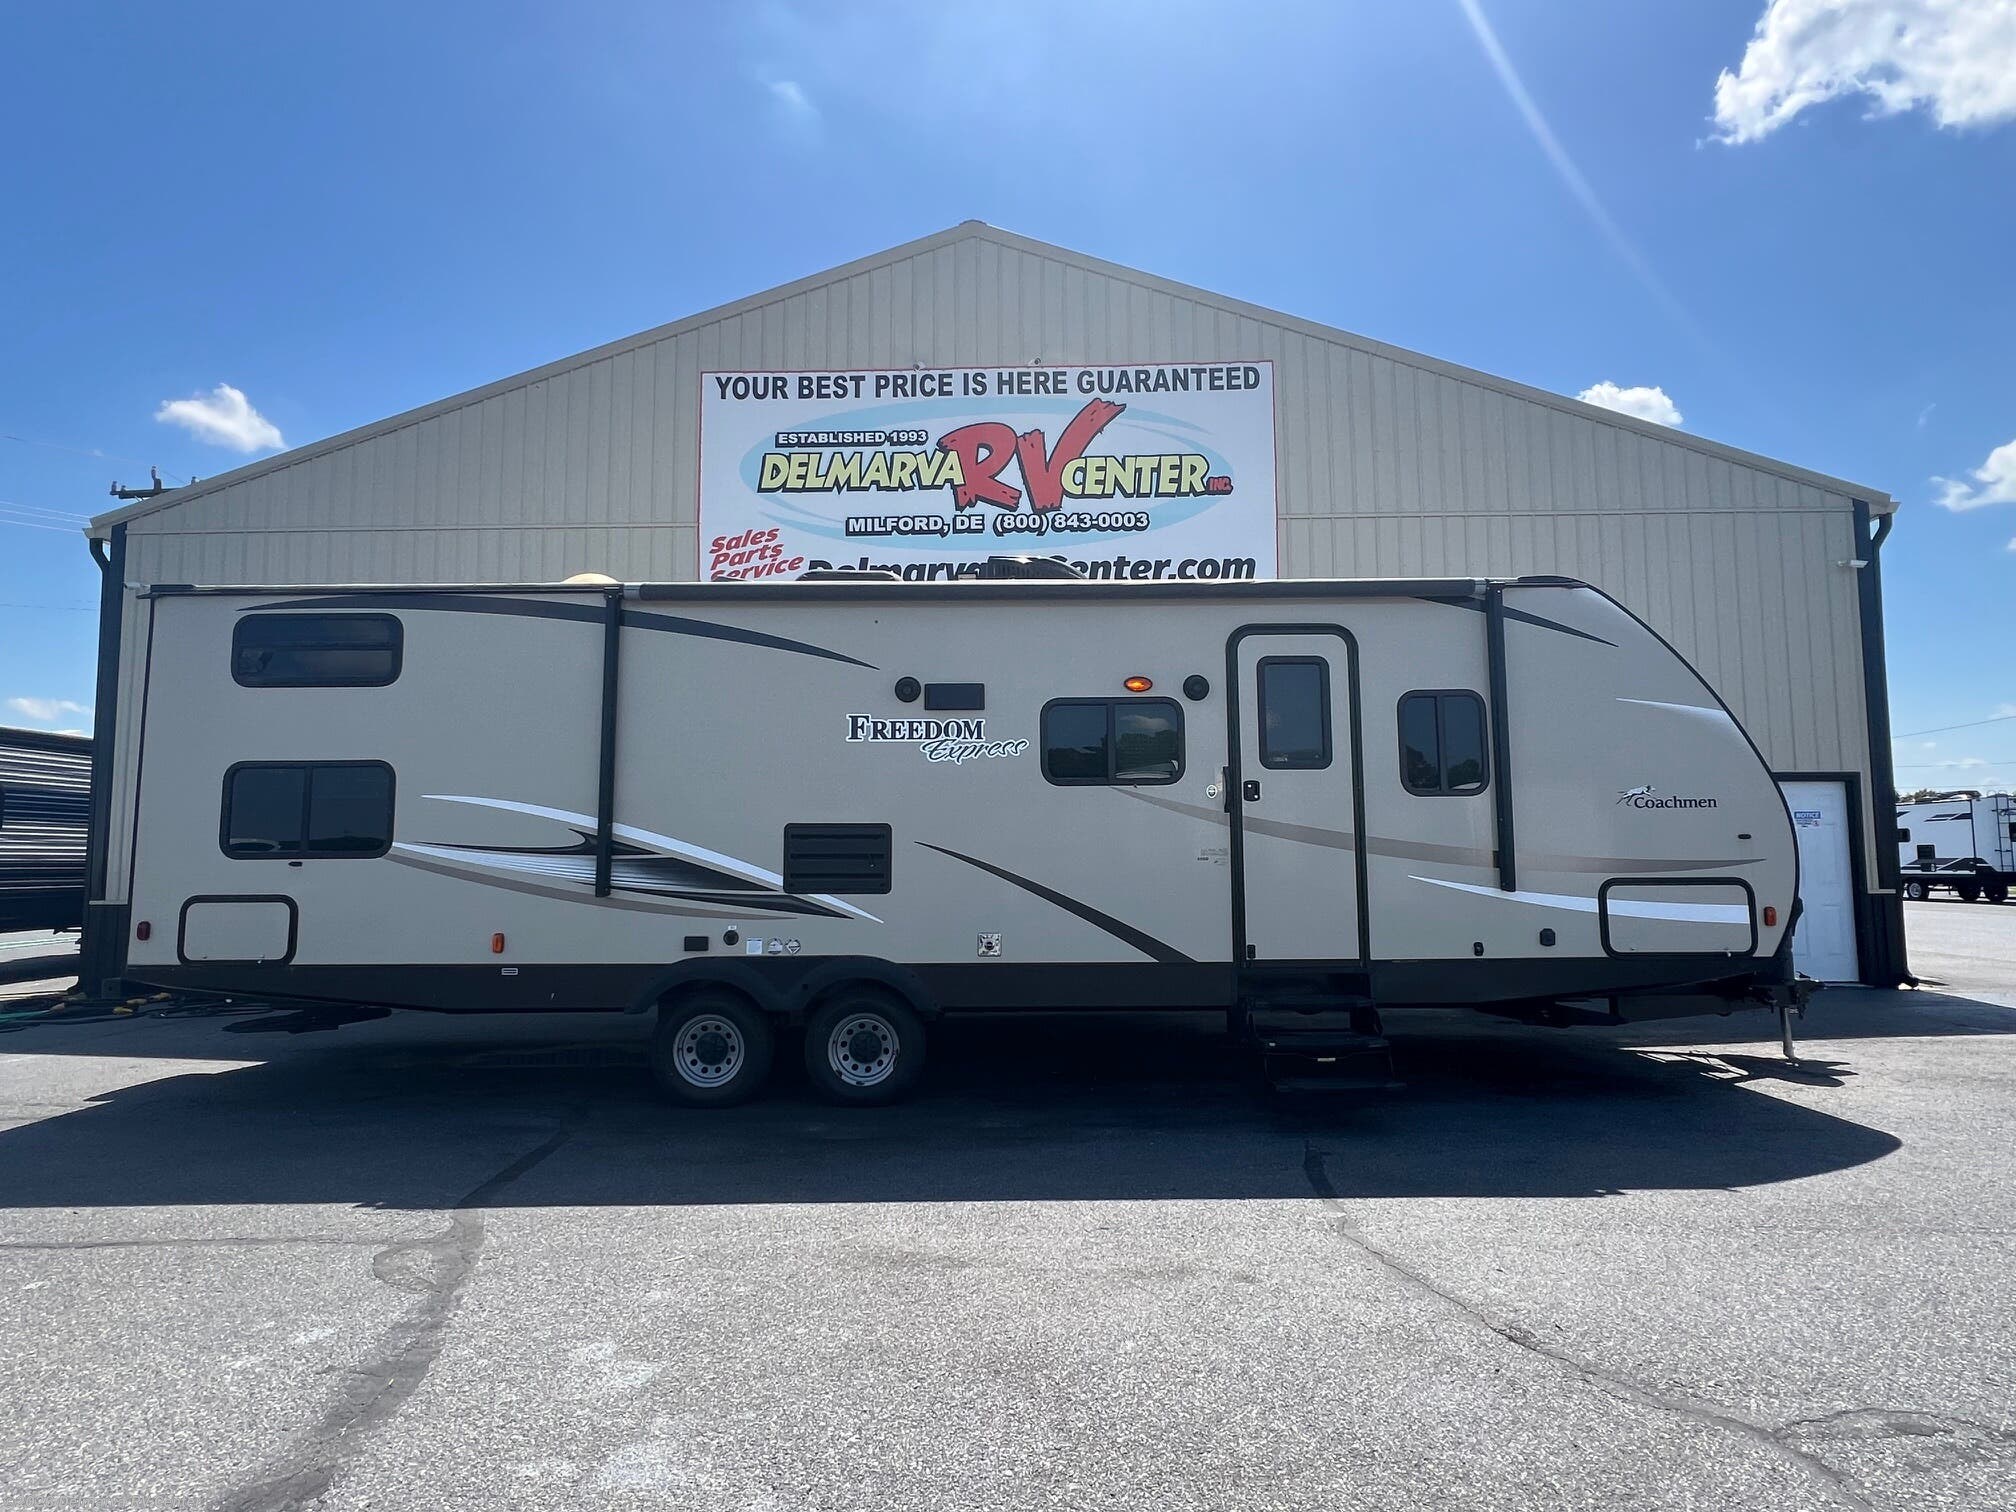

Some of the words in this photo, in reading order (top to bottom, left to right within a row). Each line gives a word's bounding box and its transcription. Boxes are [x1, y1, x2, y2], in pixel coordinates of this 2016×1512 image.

[715, 376, 789, 400] YOUR
[798, 375, 866, 399] BEST
[875, 373, 953, 398] PRICE
[963, 372, 988, 396] IS
[997, 371, 1068, 395] HERE
[1077, 366, 1261, 394] GUARANTEED
[777, 431, 886, 446] ESTABLISHED
[890, 430, 928, 443] 1993
[758, 450, 966, 493] DELMARVA
[937, 397, 1127, 513] RV
[1060, 454, 1210, 499] CENTER
[846, 516, 951, 538] MILFORD,
[954, 514, 985, 533] DE
[993, 513, 1049, 537] (800)
[1052, 512, 1149, 533] 843-0003
[709, 528, 780, 554] Sales
[710, 543, 784, 571] Parts
[847, 714, 985, 741] FREEDOM
[920, 737, 1029, 764] Express
[1634, 795, 1718, 809] Coachmen
